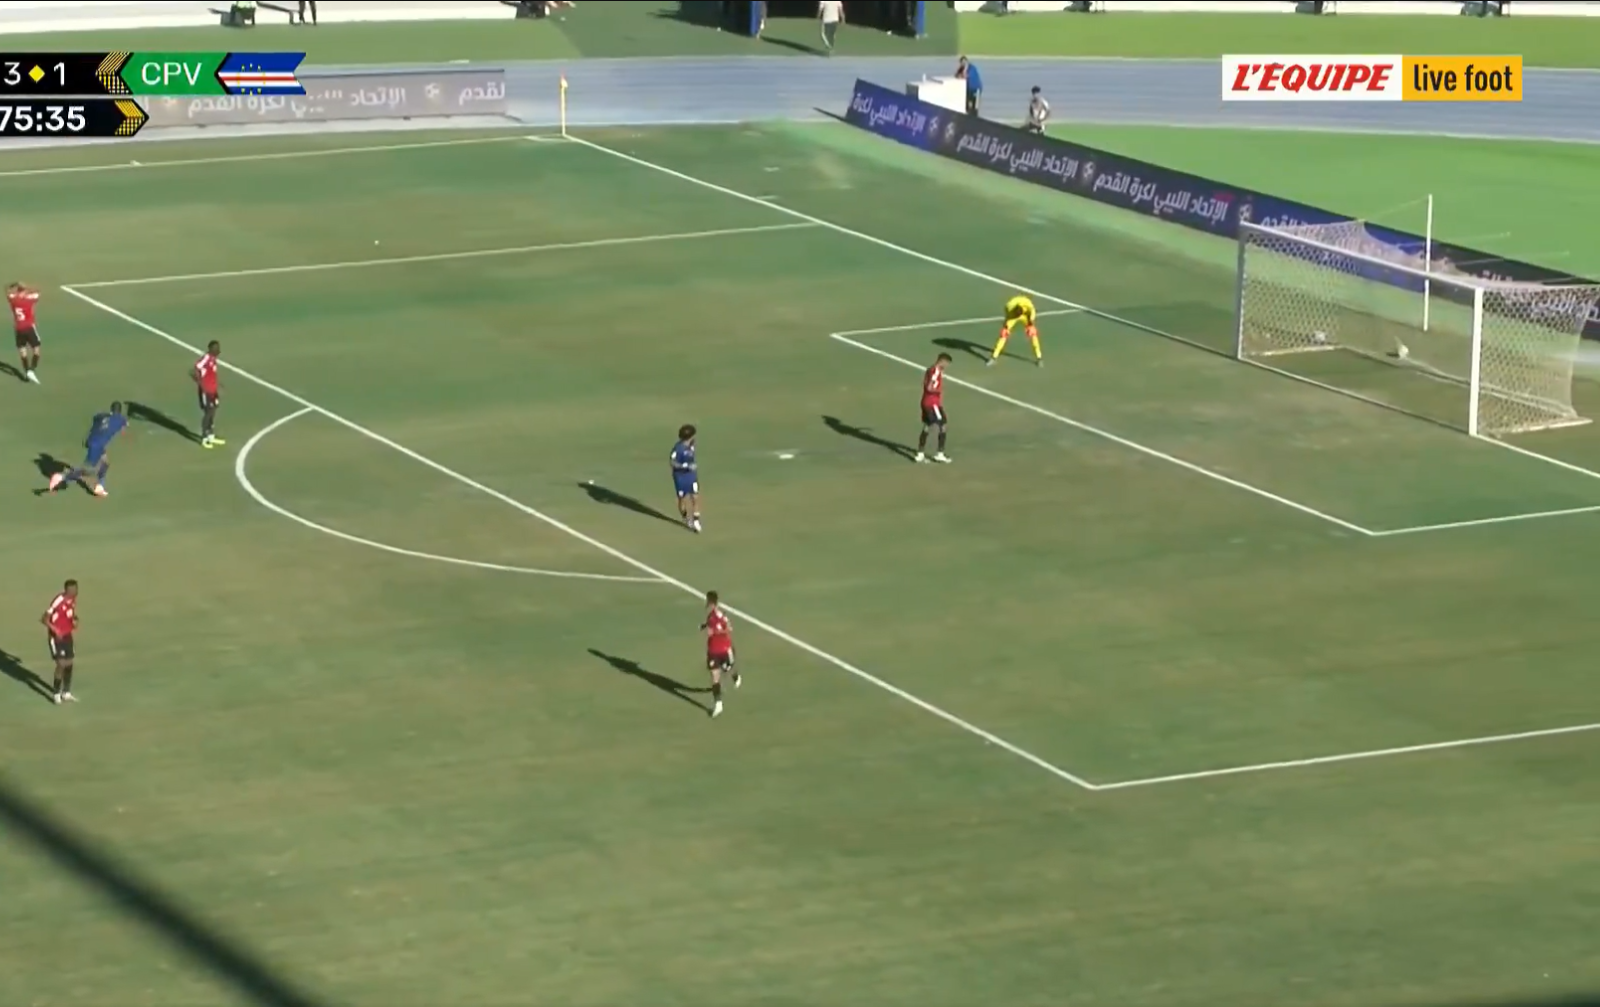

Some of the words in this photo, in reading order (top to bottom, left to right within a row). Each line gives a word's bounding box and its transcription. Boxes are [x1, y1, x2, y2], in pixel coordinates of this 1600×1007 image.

[956, 133, 991, 152] القدم
[988, 137, 1013, 162] لكرة
[1093, 172, 1131, 192] القدم
[1128, 177, 1157, 203] لكرة
[15, 307, 26, 321] 5
